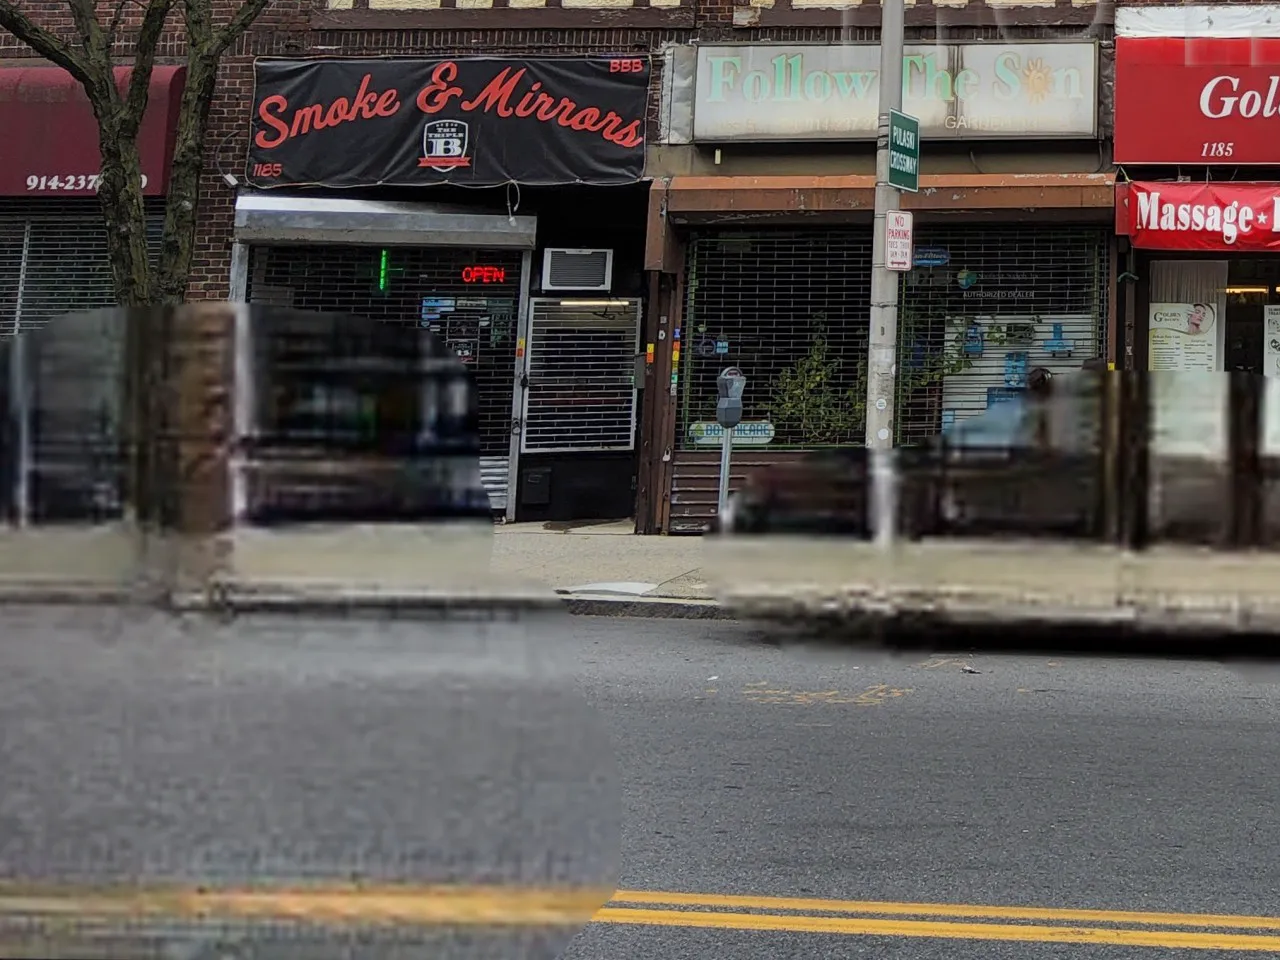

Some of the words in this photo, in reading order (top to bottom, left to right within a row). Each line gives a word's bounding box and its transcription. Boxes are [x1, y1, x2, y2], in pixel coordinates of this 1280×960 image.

[610, 59, 643, 73] BBB
[706, 53, 880, 103] Follow
[902, 53, 981, 103] The
[255, 74, 401, 149] Smoke
[416, 61, 463, 113] &
[461, 66, 643, 148] Mirrors
[893, 125, 915, 150] PULASKI
[427, 138, 462, 156] B
[1201, 142, 1234, 158] 1185
[253, 163, 283, 177] 1185
[890, 150, 917, 175] CROSSWAY
[26, 174, 148, 190] 914-237
[895, 215, 905, 227] NO
[1136, 192, 1253, 245] Massage
[888, 228, 910, 240] PARKING
[462, 267, 505, 282] OPEN
[705, 424, 770, 436] BONICARE
